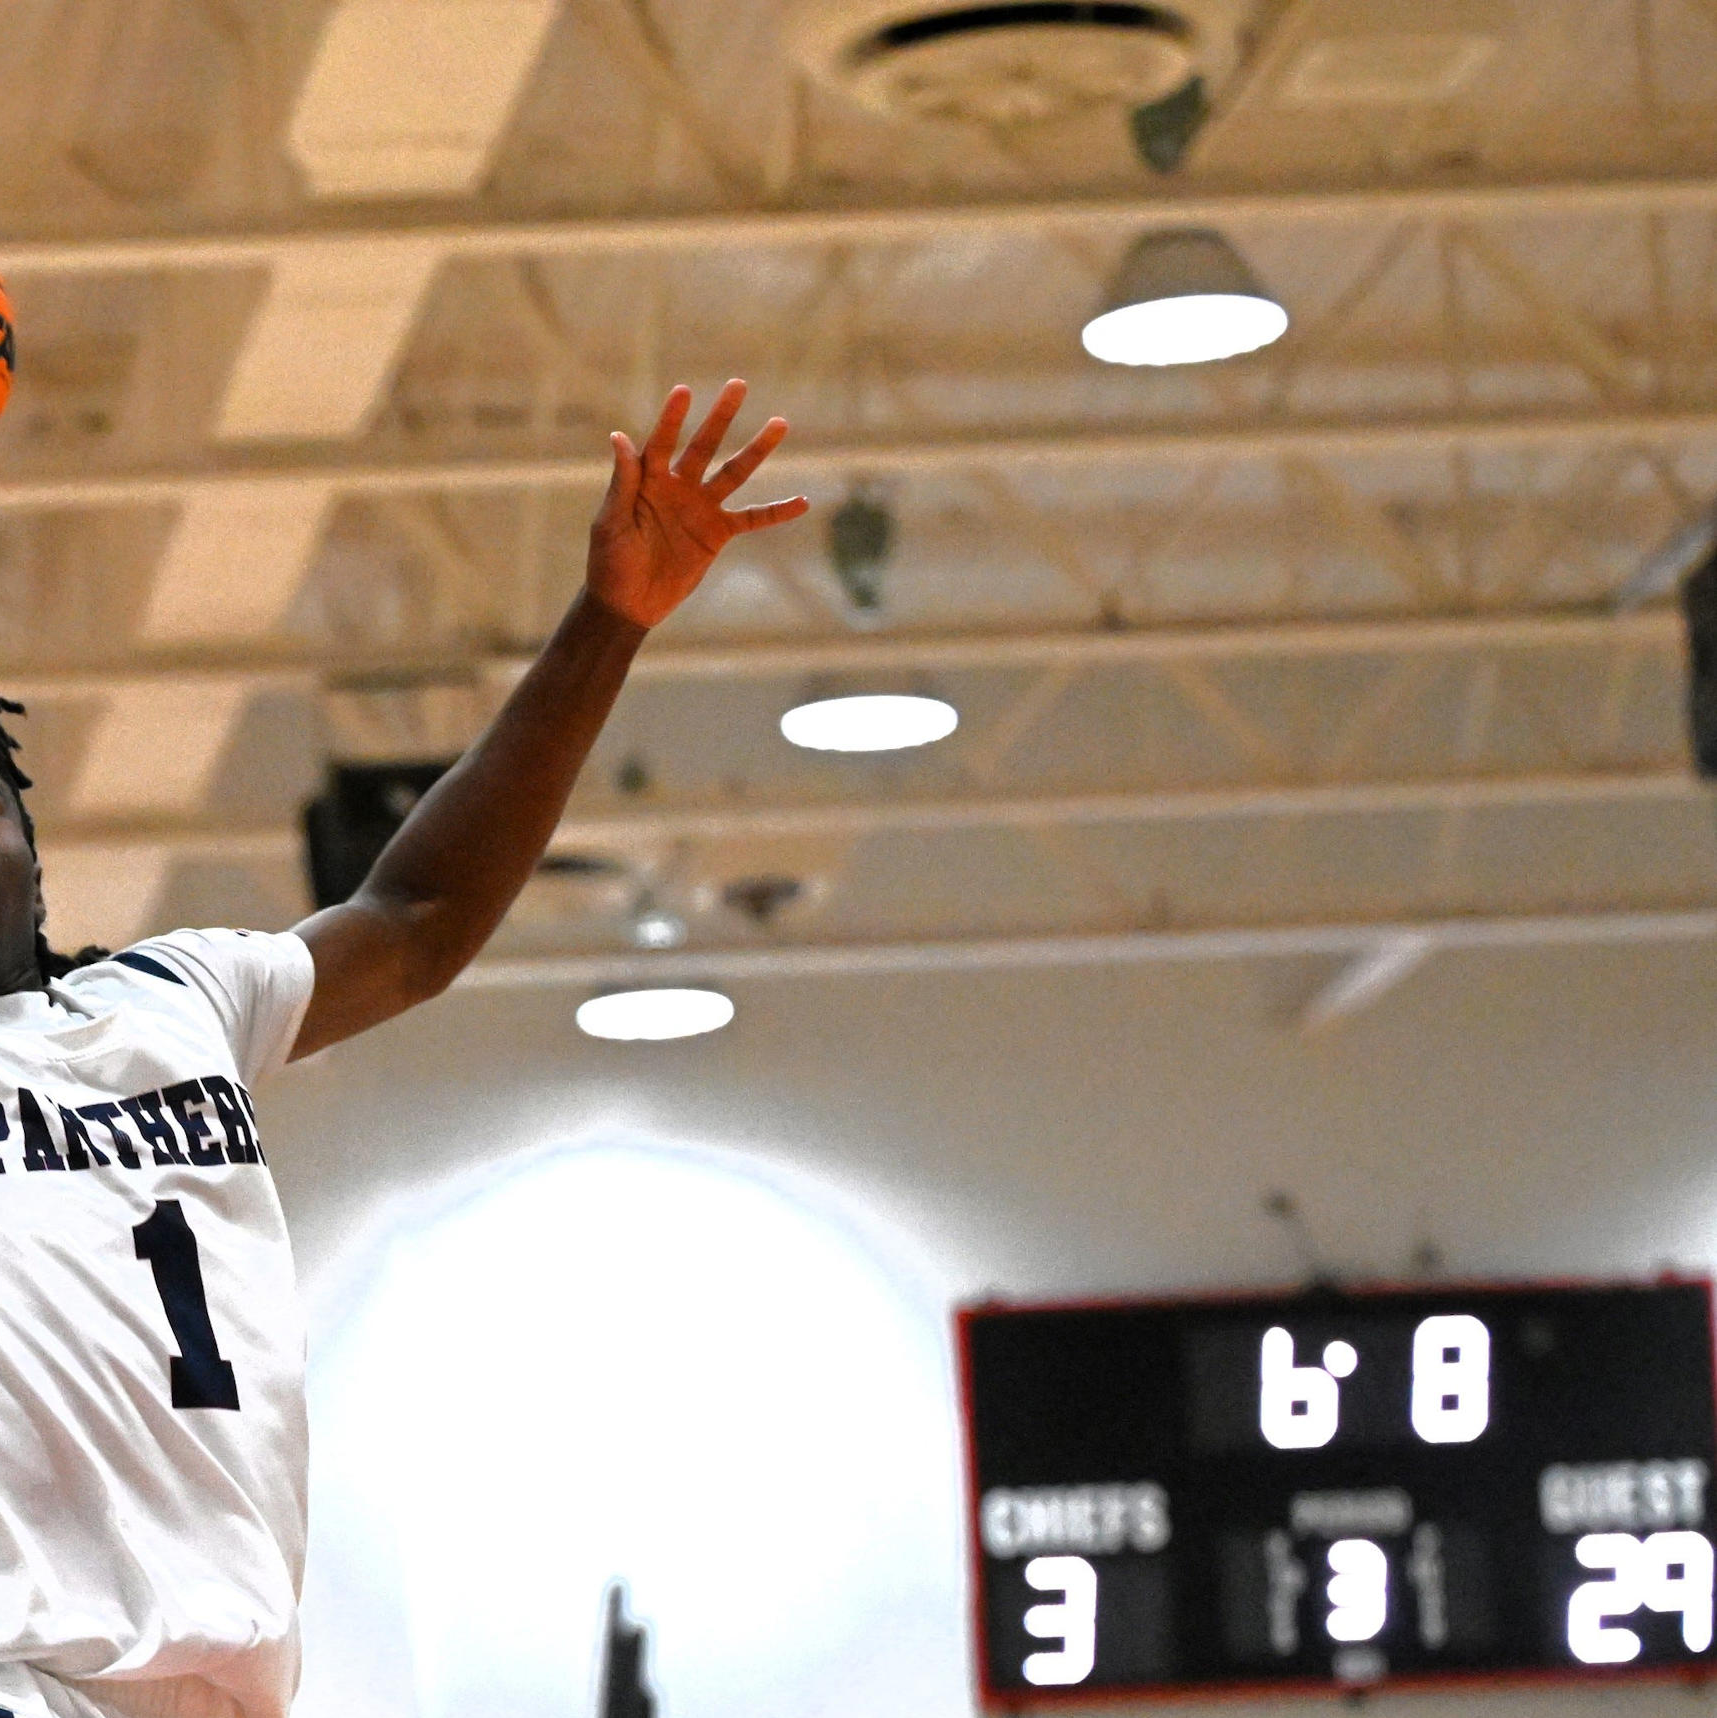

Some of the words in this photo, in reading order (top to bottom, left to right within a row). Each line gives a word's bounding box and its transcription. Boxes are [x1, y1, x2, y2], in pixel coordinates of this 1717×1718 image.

[132, 1199, 240, 1411] 1
[1022, 1556, 1097, 1686] 3
[1567, 1531, 1714, 1664] 29
